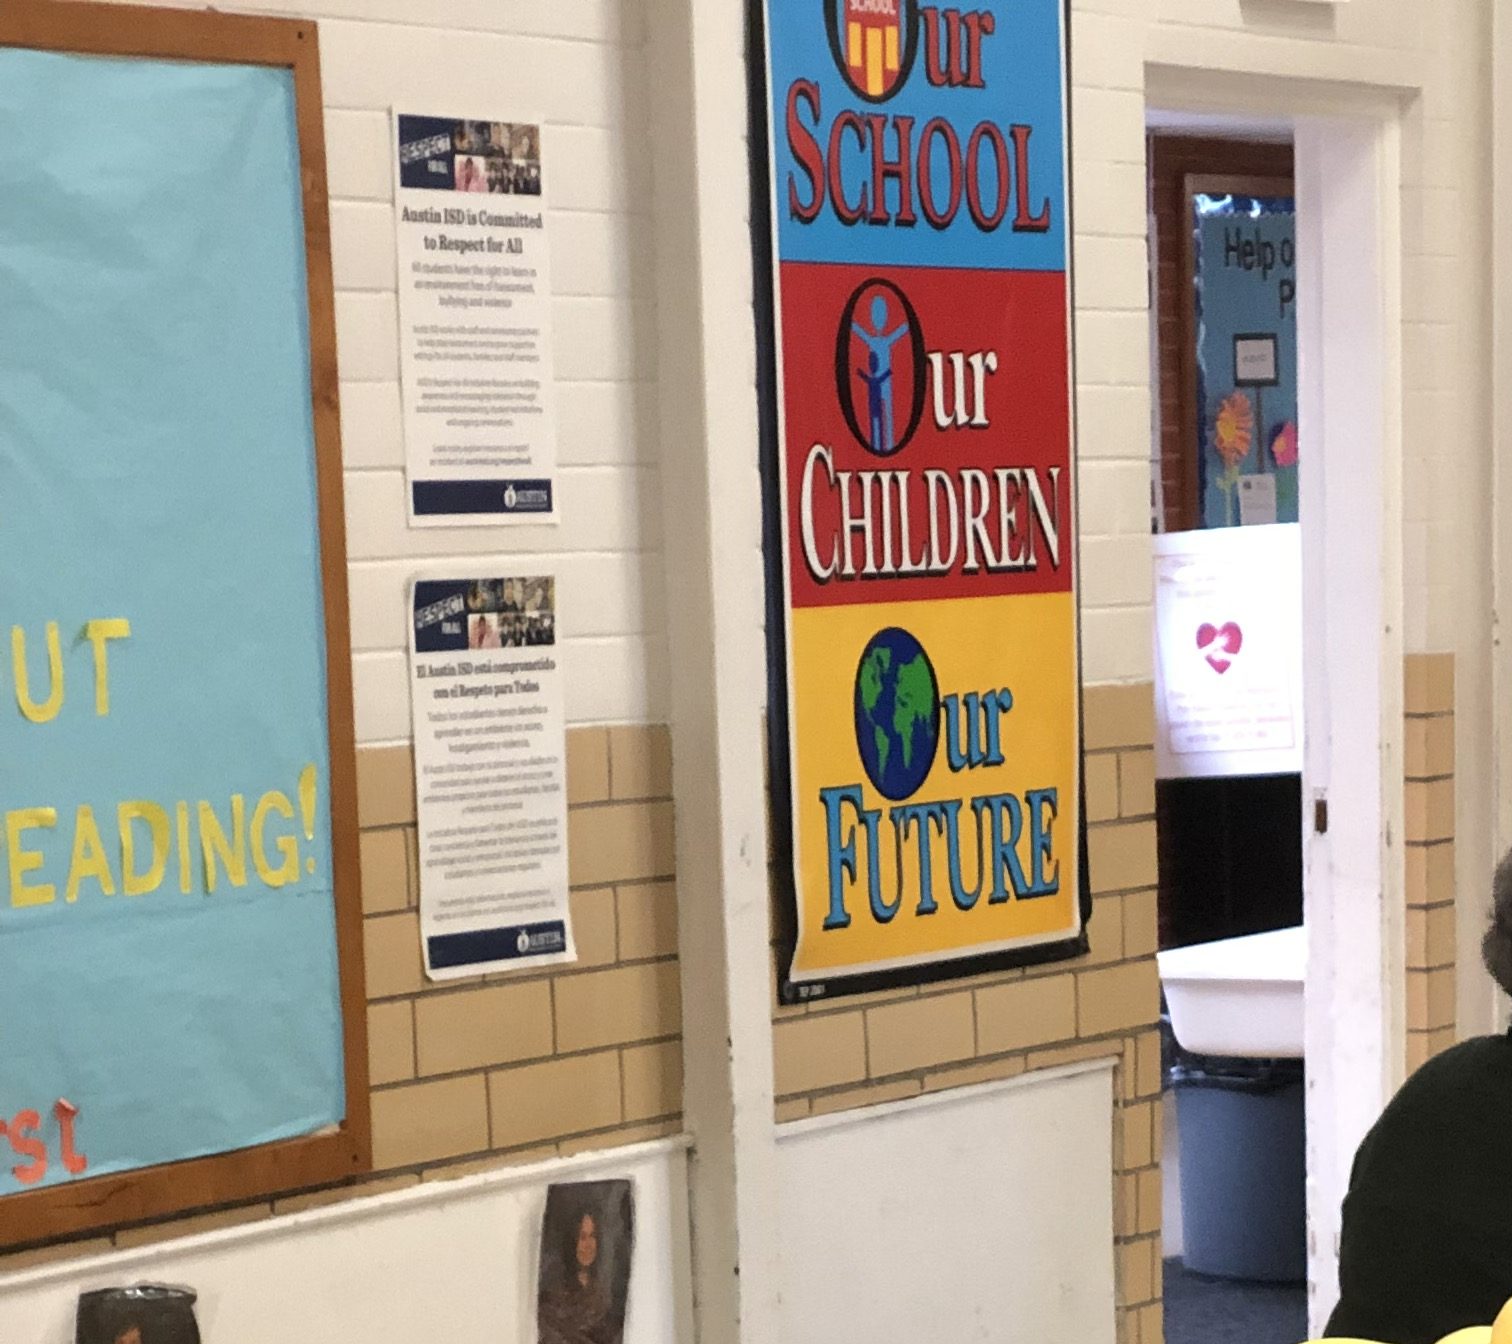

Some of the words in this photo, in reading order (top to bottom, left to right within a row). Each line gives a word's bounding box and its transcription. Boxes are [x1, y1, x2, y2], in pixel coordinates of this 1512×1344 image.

[402, 206, 442, 223] Austin
[443, 208, 465, 225] ISD
[466, 210, 477, 226] is
[479, 211, 543, 229] Committed
[784, 78, 1051, 233] SCHOOL
[424, 236, 437, 250] to
[438, 234, 485, 254] Respect
[487, 237, 504, 253] for
[505, 238, 523, 254] All
[1223, 226, 1275, 281] Help
[835, 277, 998, 456] Our
[801, 443, 1060, 584] CHILDREN
[0, 764, 317, 908] EADING!
[819, 783, 1060, 931] FUTURE
